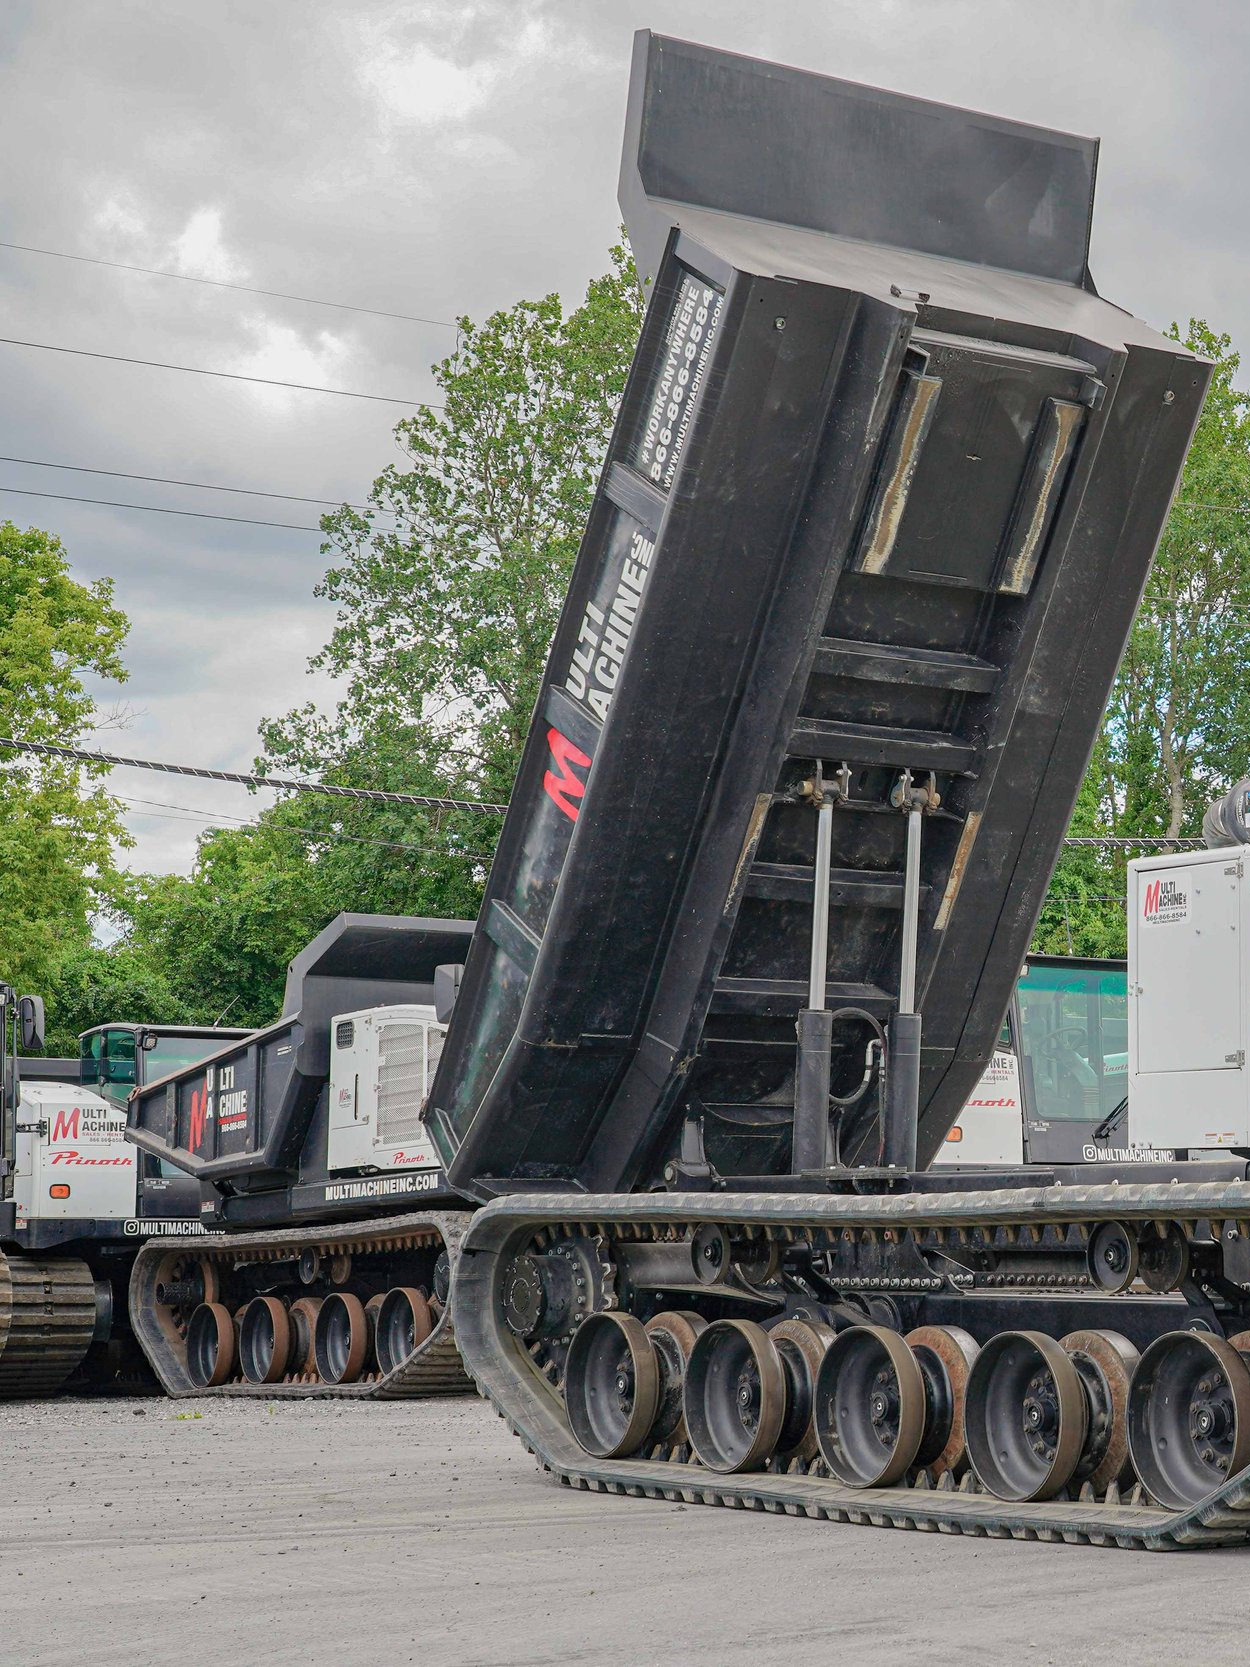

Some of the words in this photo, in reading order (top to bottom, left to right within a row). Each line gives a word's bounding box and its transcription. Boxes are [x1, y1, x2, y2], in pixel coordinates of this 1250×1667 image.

[641, 286, 700, 464] #WORKANYWHERE
[651, 289, 714, 481] 866-866-8584
[664, 296, 725, 488] WWW.MULTIMACHINEINC.COM
[1146, 912, 1187, 921] 866-866-8584
[49, 1151, 133, 1166] Prinoth
[393, 1151, 425, 1165] Prinoth
[1097, 1148, 1172, 1162] MULTIMACHINEINC
[325, 1174, 438, 1201] MULTIMACHINEINC.COM
